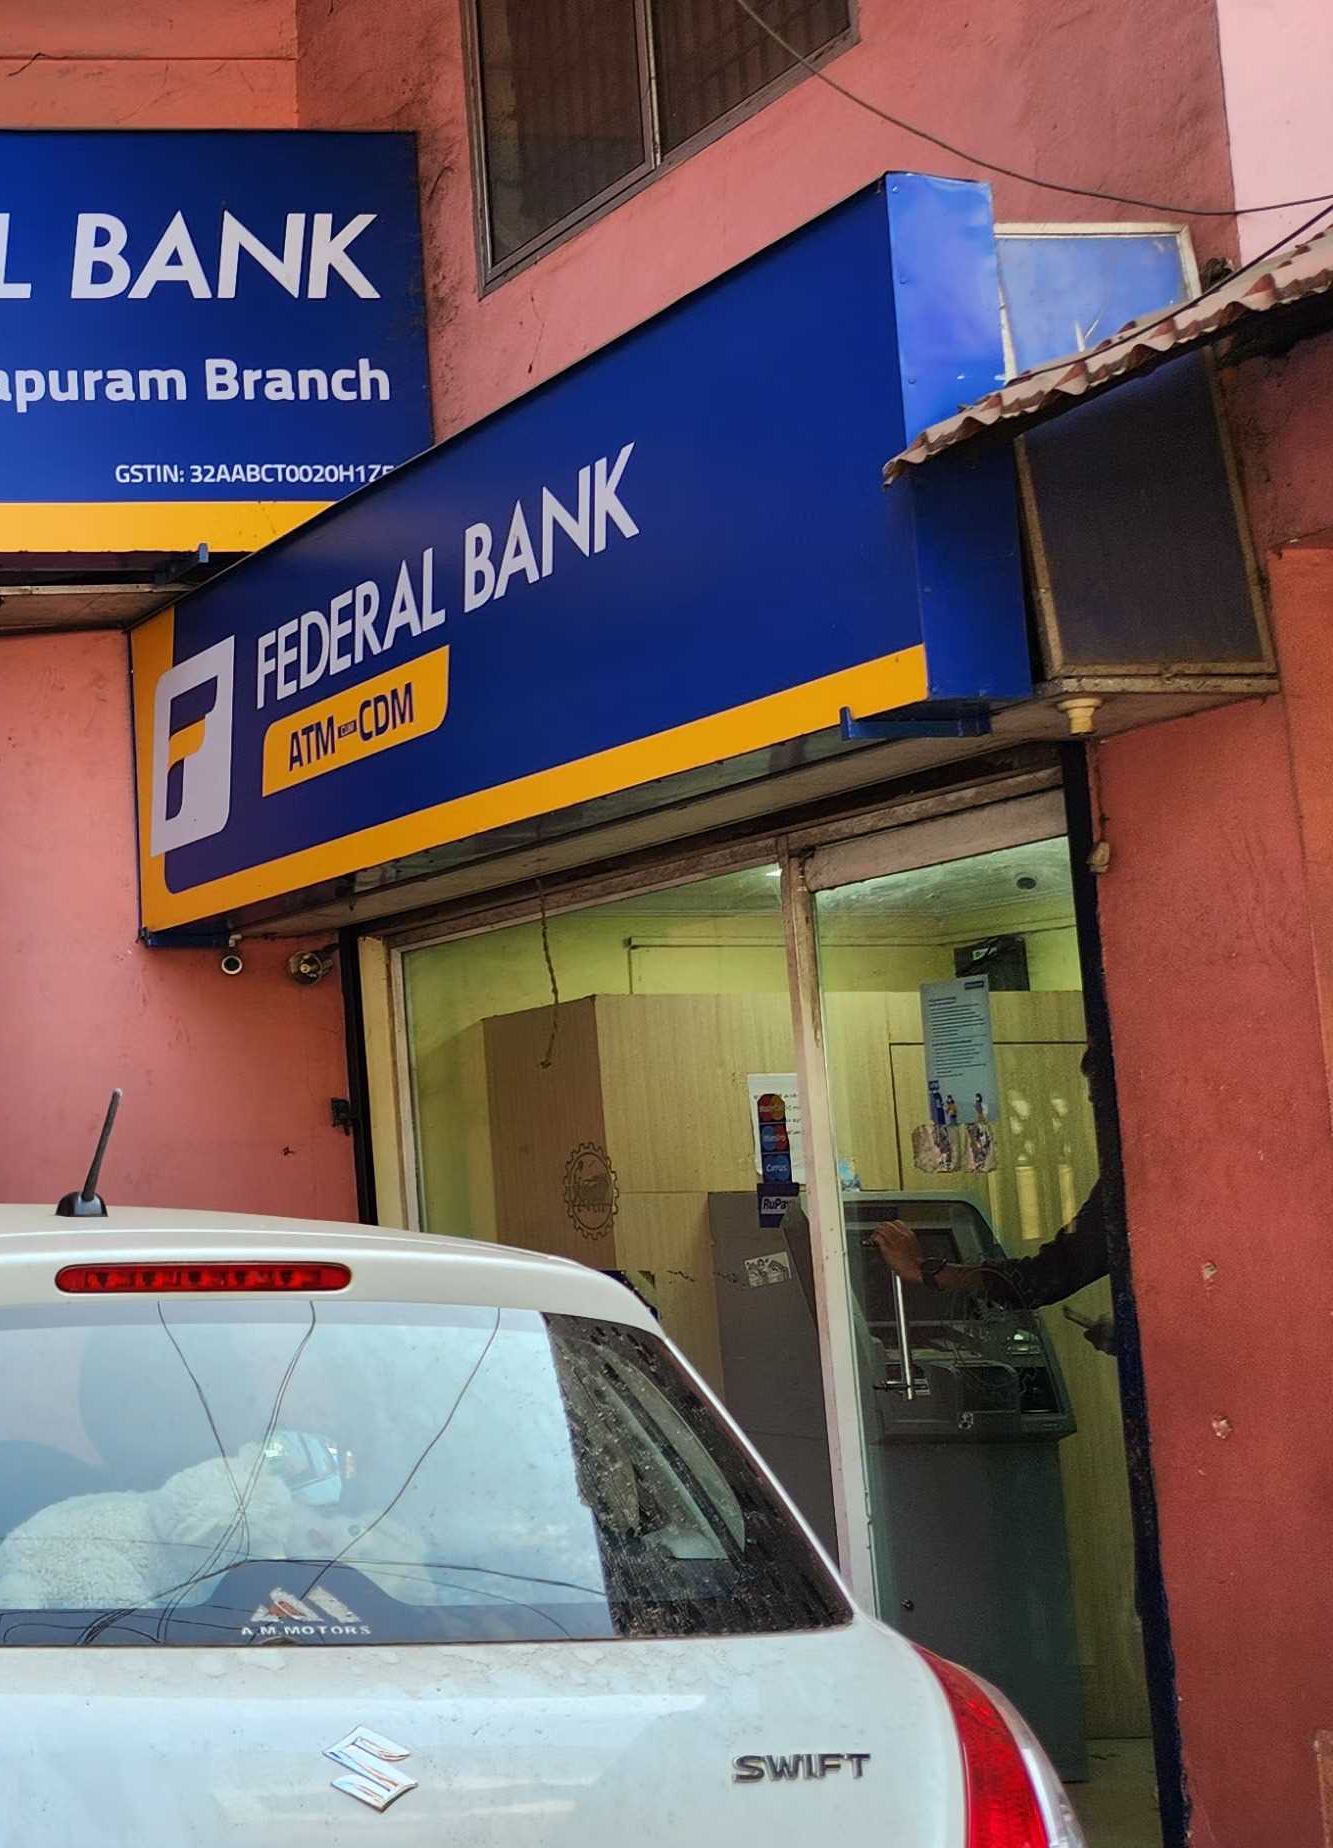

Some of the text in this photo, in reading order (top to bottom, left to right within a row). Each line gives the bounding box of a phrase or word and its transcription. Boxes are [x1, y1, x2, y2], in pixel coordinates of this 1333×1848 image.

[70, 210, 381, 299] BANK
[205, 358, 390, 401] Branch
[115, 464, 184, 483] GSTIN:
[257, 443, 639, 709] FEDERAL BANK
[289, 715, 335, 771] ATM
[359, 682, 414, 741] CDM
[732, 1753, 871, 1783] SWIFT
